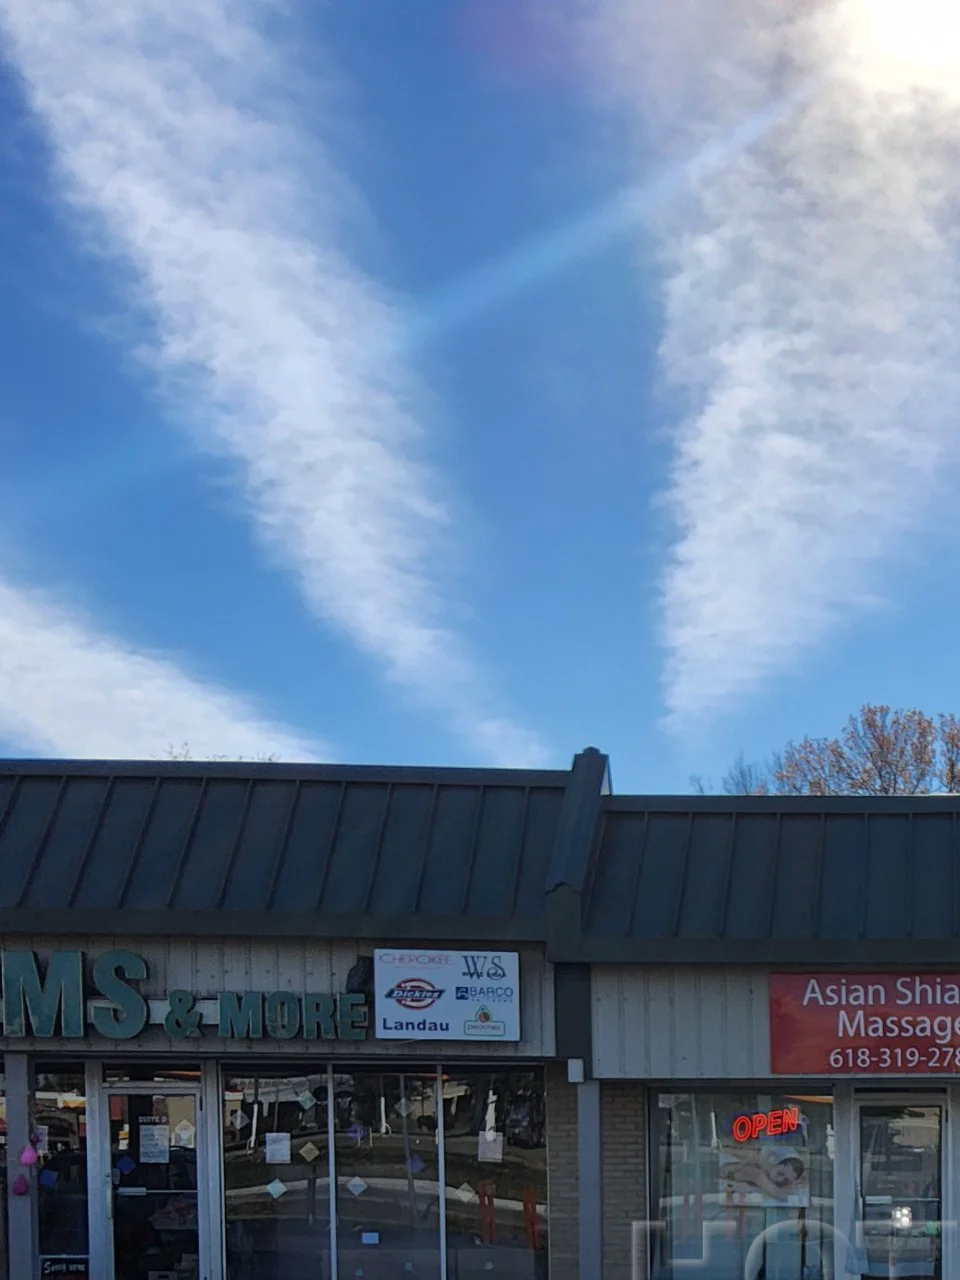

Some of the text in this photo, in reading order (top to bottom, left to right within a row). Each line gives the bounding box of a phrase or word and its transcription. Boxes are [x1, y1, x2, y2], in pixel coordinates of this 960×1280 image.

[1, 949, 370, 1040] MS & MORE
[392, 989, 441, 999] Dickies
[470, 986, 514, 997] BARCO
[802, 978, 886, 1006] Asian
[383, 1018, 449, 1031] Landau
[732, 1107, 800, 1142] OPEN
